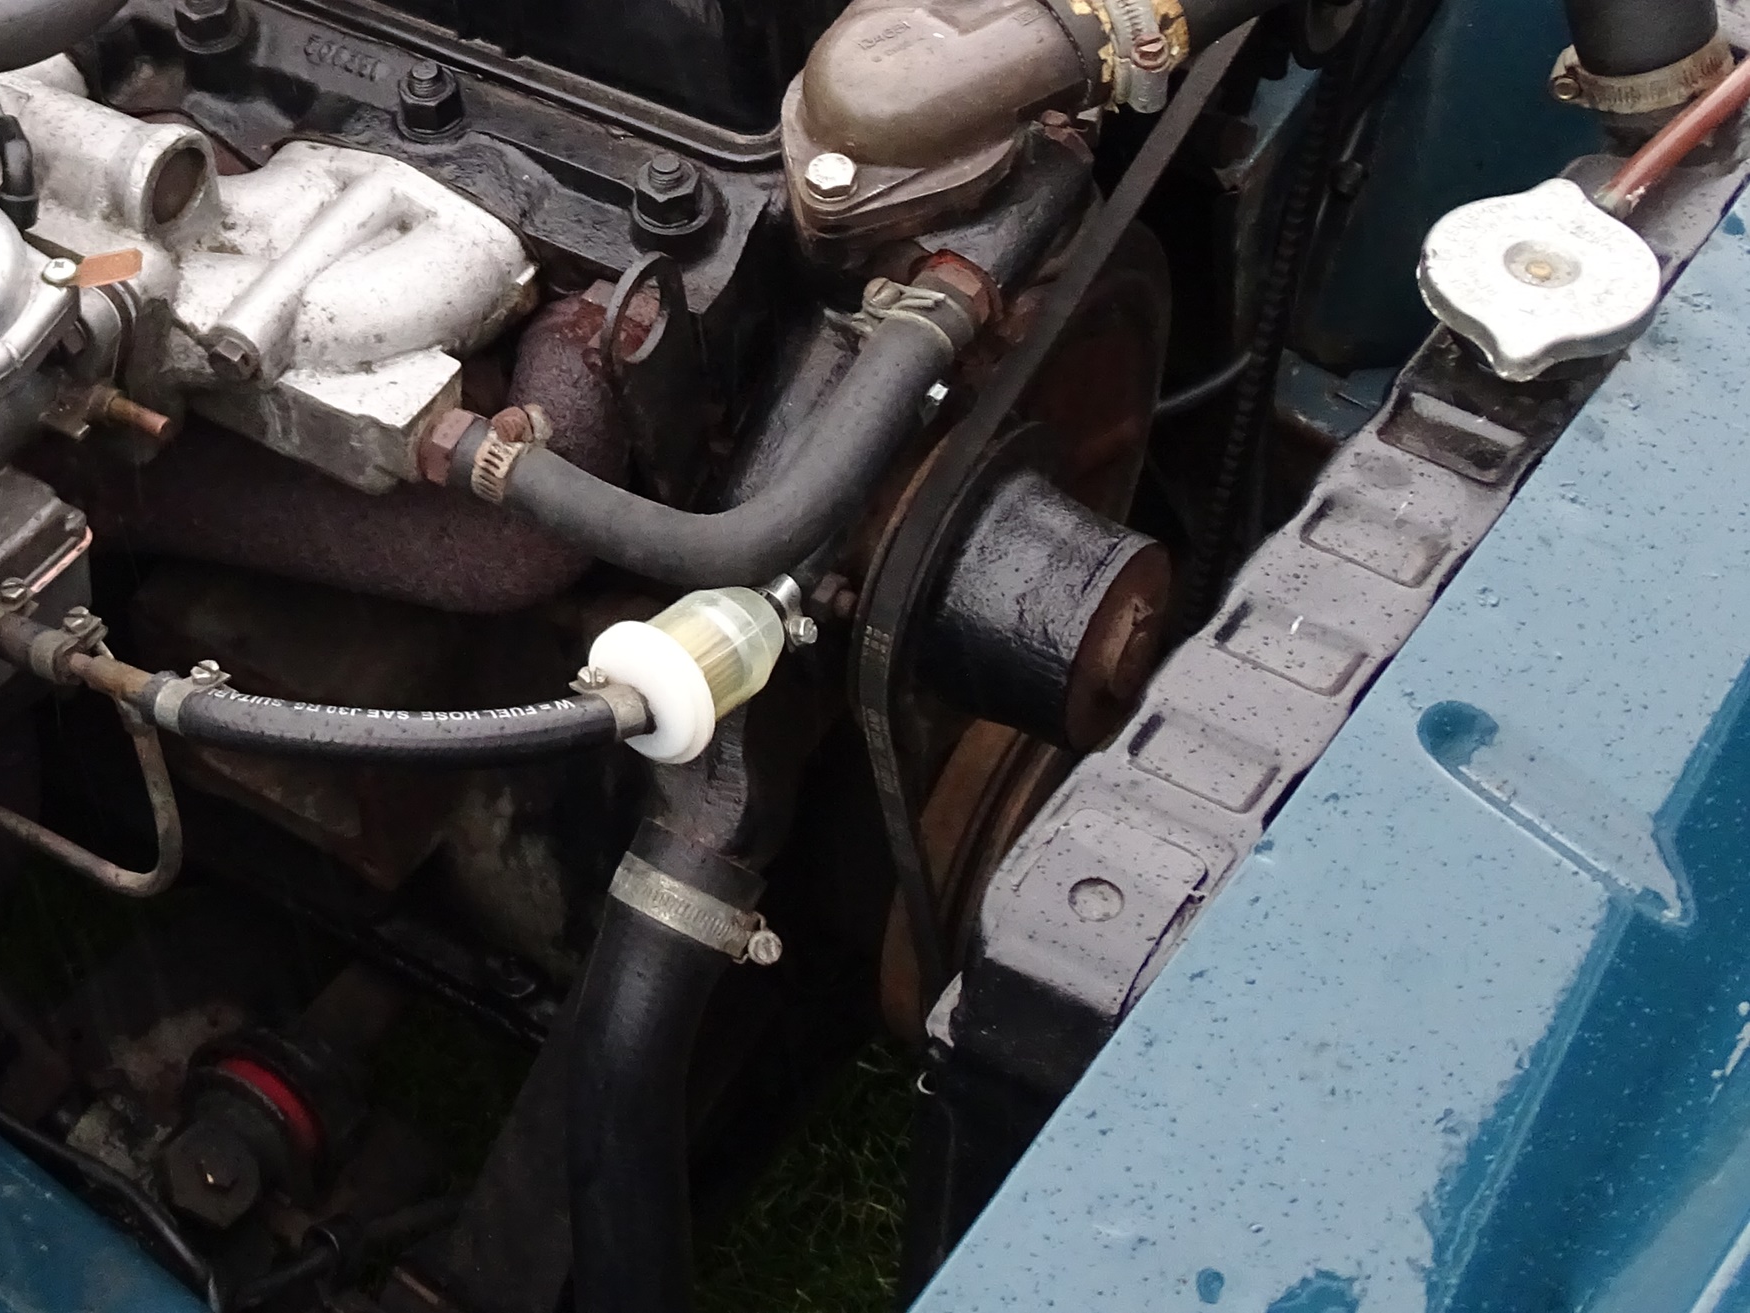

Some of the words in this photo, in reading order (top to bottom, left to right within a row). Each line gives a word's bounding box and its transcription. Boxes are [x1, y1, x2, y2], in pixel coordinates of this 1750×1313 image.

[326, 705, 363, 717] J30
[366, 709, 410, 720] SAE
[421, 710, 481, 722] HOSE
[483, 705, 538, 719] FUEL
